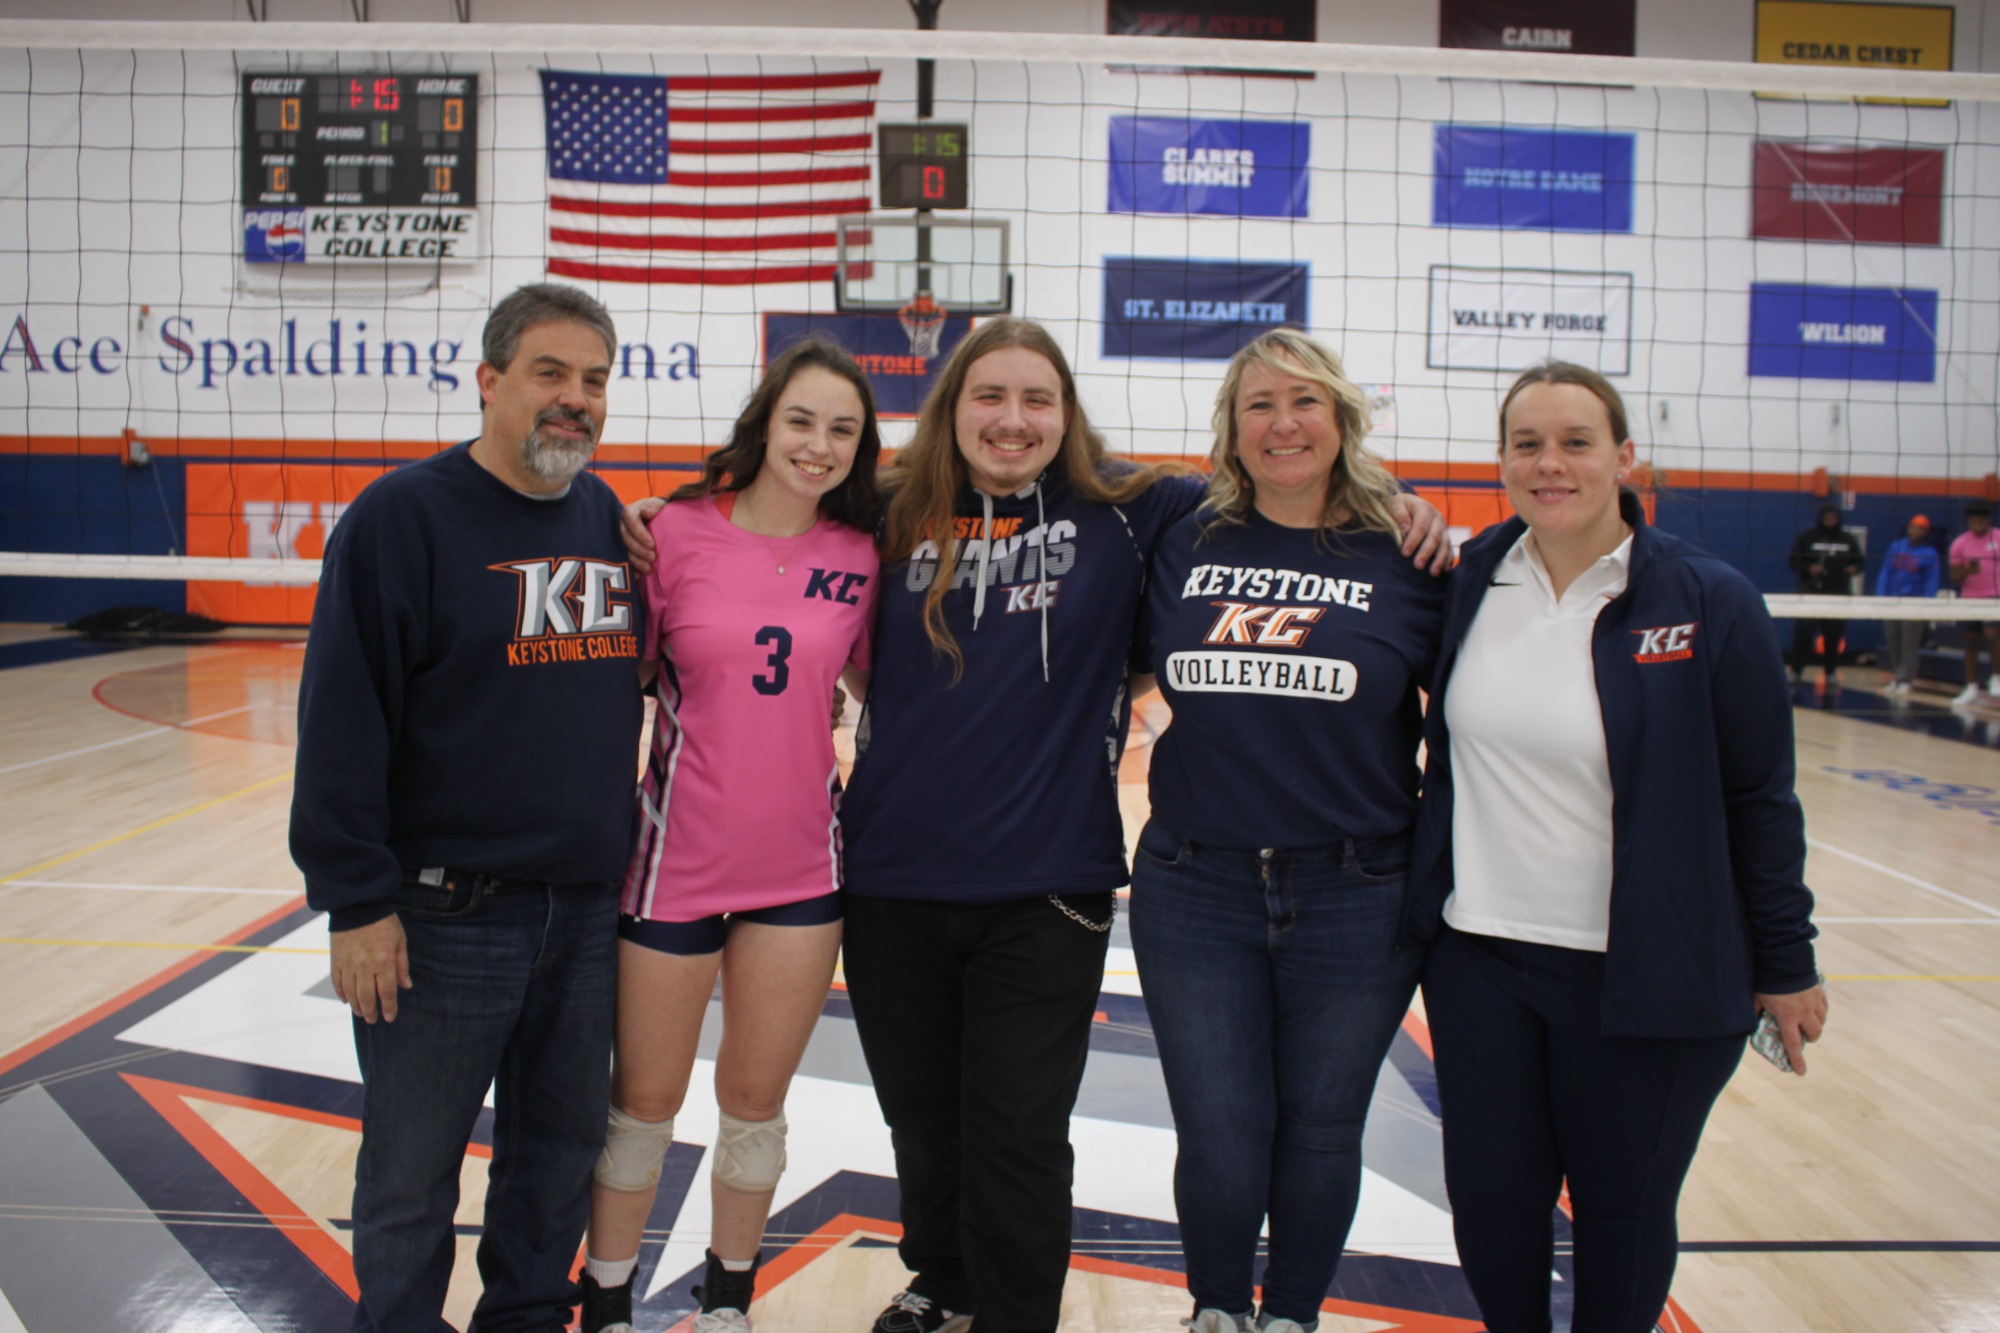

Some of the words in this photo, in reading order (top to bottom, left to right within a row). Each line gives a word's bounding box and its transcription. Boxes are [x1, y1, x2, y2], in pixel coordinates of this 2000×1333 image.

[1502, 27, 1573, 48] CAIRN
[1782, 41, 1851, 62] CEDAR
[1856, 44, 1924, 65] CREST
[416, 78, 467, 95] HOME
[281, 97, 300, 131] 0
[443, 97, 464, 131] 0
[1163, 147, 1255, 167] CLARKS
[923, 165, 945, 199] 0
[1162, 164, 1255, 188] SUMMIT
[244, 210, 305, 231] PEPSI
[310, 213, 472, 233] KEYSTONE
[323, 237, 458, 258] COLLEGE
[1124, 298, 1160, 320] ST.
[1164, 301, 1287, 322] ELIZABETH
[1453, 309, 1535, 330] VALLEY
[1543, 313, 1608, 332] FORGE
[1801, 321, 1886, 345] WILSON
[0, 313, 121, 375] Ace
[158, 315, 464, 395] Spalding
[490, 557, 632, 641] KC
[803, 567, 869, 607] KC
[1182, 564, 1373, 612] KEYSTONE
[1203, 601, 1328, 648] KC
[1631, 622, 1698, 655] KC
[507, 638, 587, 667] KEYSTONE
[587, 635, 638, 660] COLLEGE
[752, 625, 793, 697] 3
[1173, 659, 1345, 694] VOLLEYBALL
